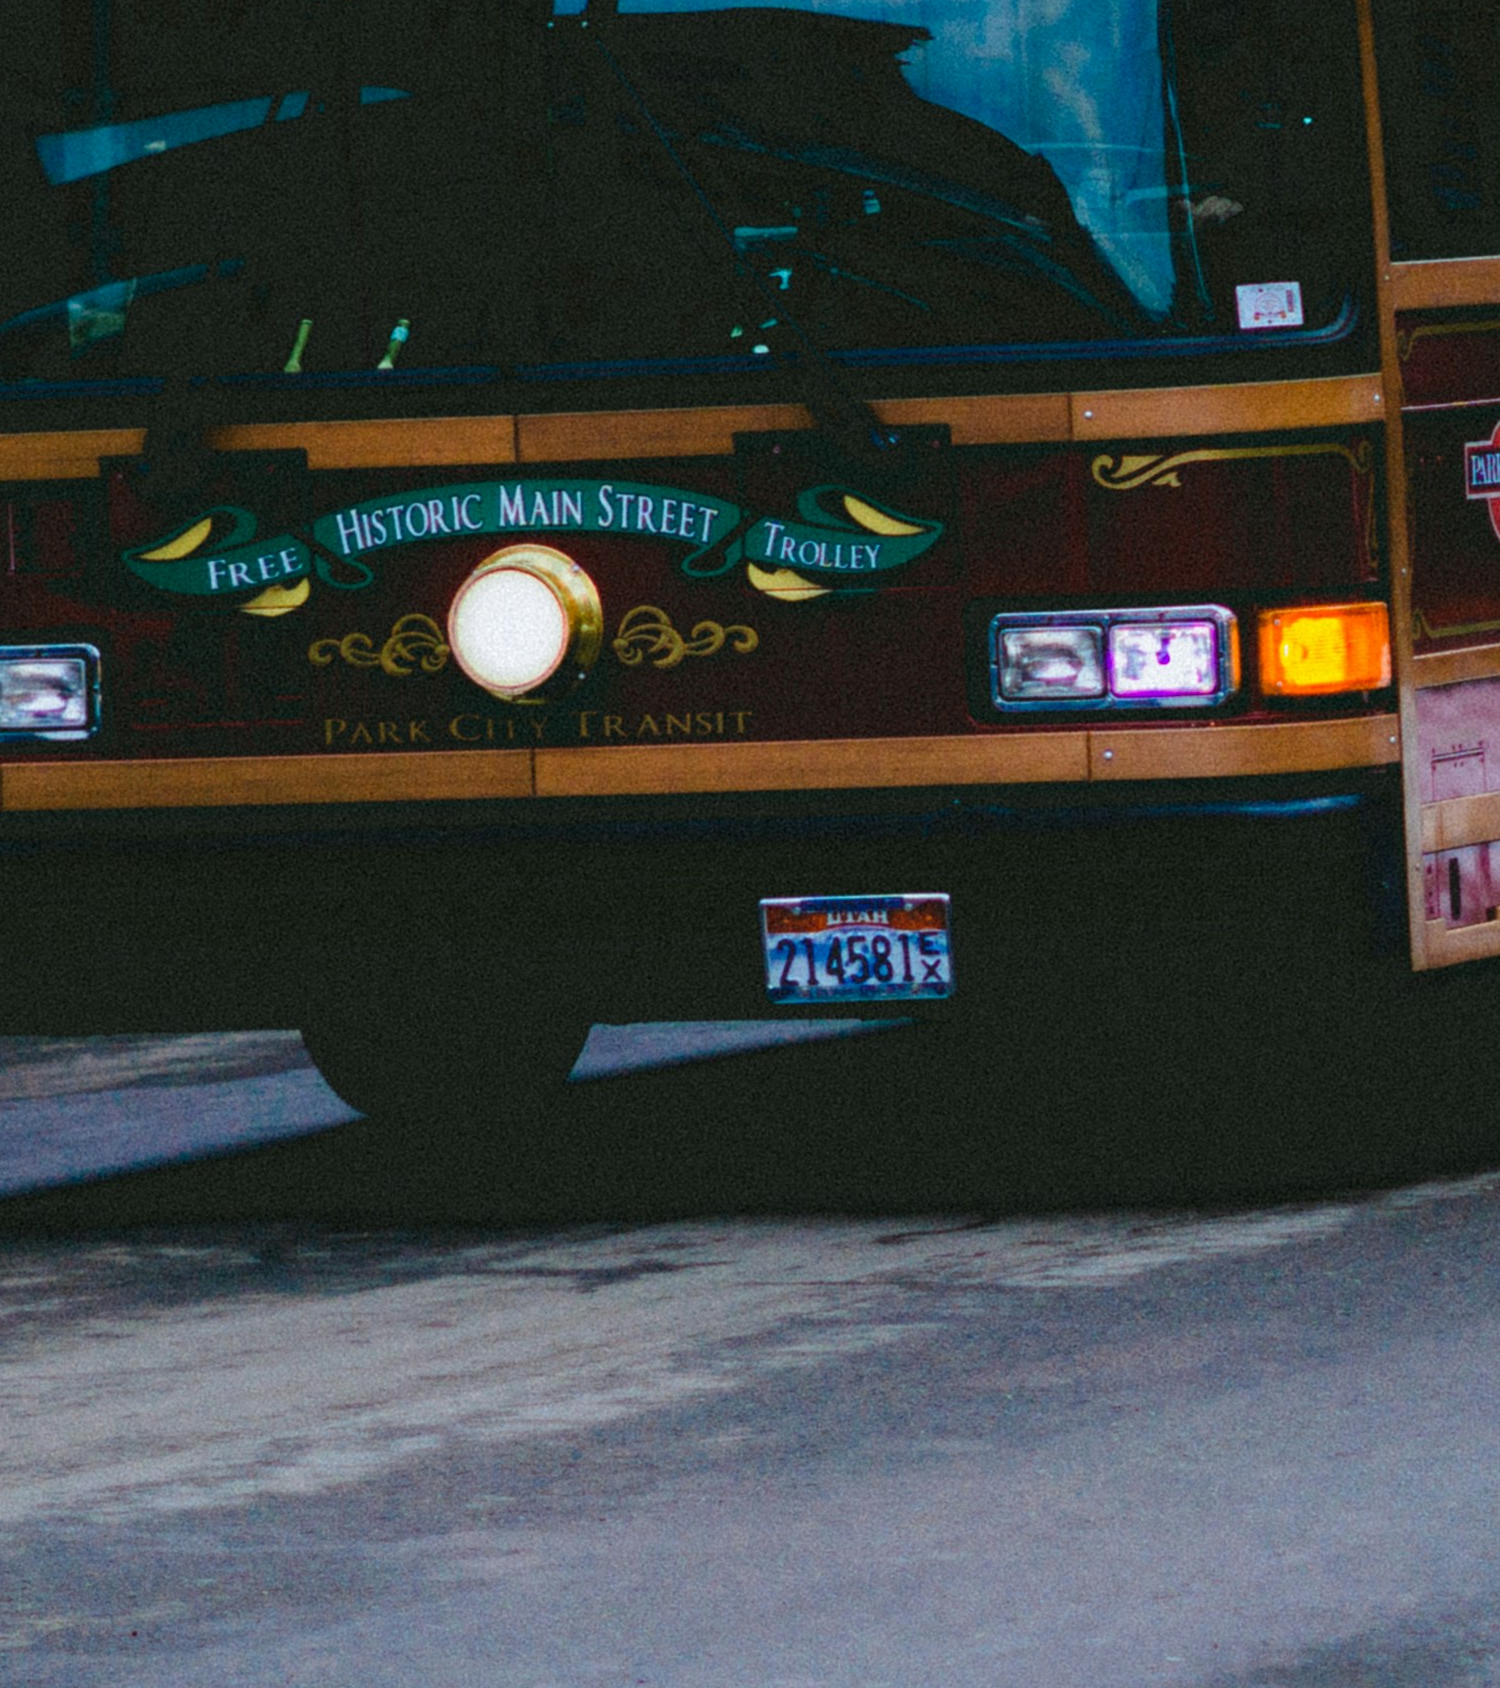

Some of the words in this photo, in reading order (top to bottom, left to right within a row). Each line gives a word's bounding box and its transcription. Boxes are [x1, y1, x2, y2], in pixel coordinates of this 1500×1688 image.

[208, 547, 303, 590] FREE
[336, 494, 483, 556] HISTORIC
[499, 484, 583, 528] MAIN
[598, 484, 719, 545] STREET
[762, 521, 882, 571] TROLLEY
[322, 716, 433, 746] PARK
[448, 714, 551, 742] CITY
[572, 710, 754, 739] TRANSIT
[827, 910, 890, 925] UTAH
[777, 934, 913, 986] 214581
